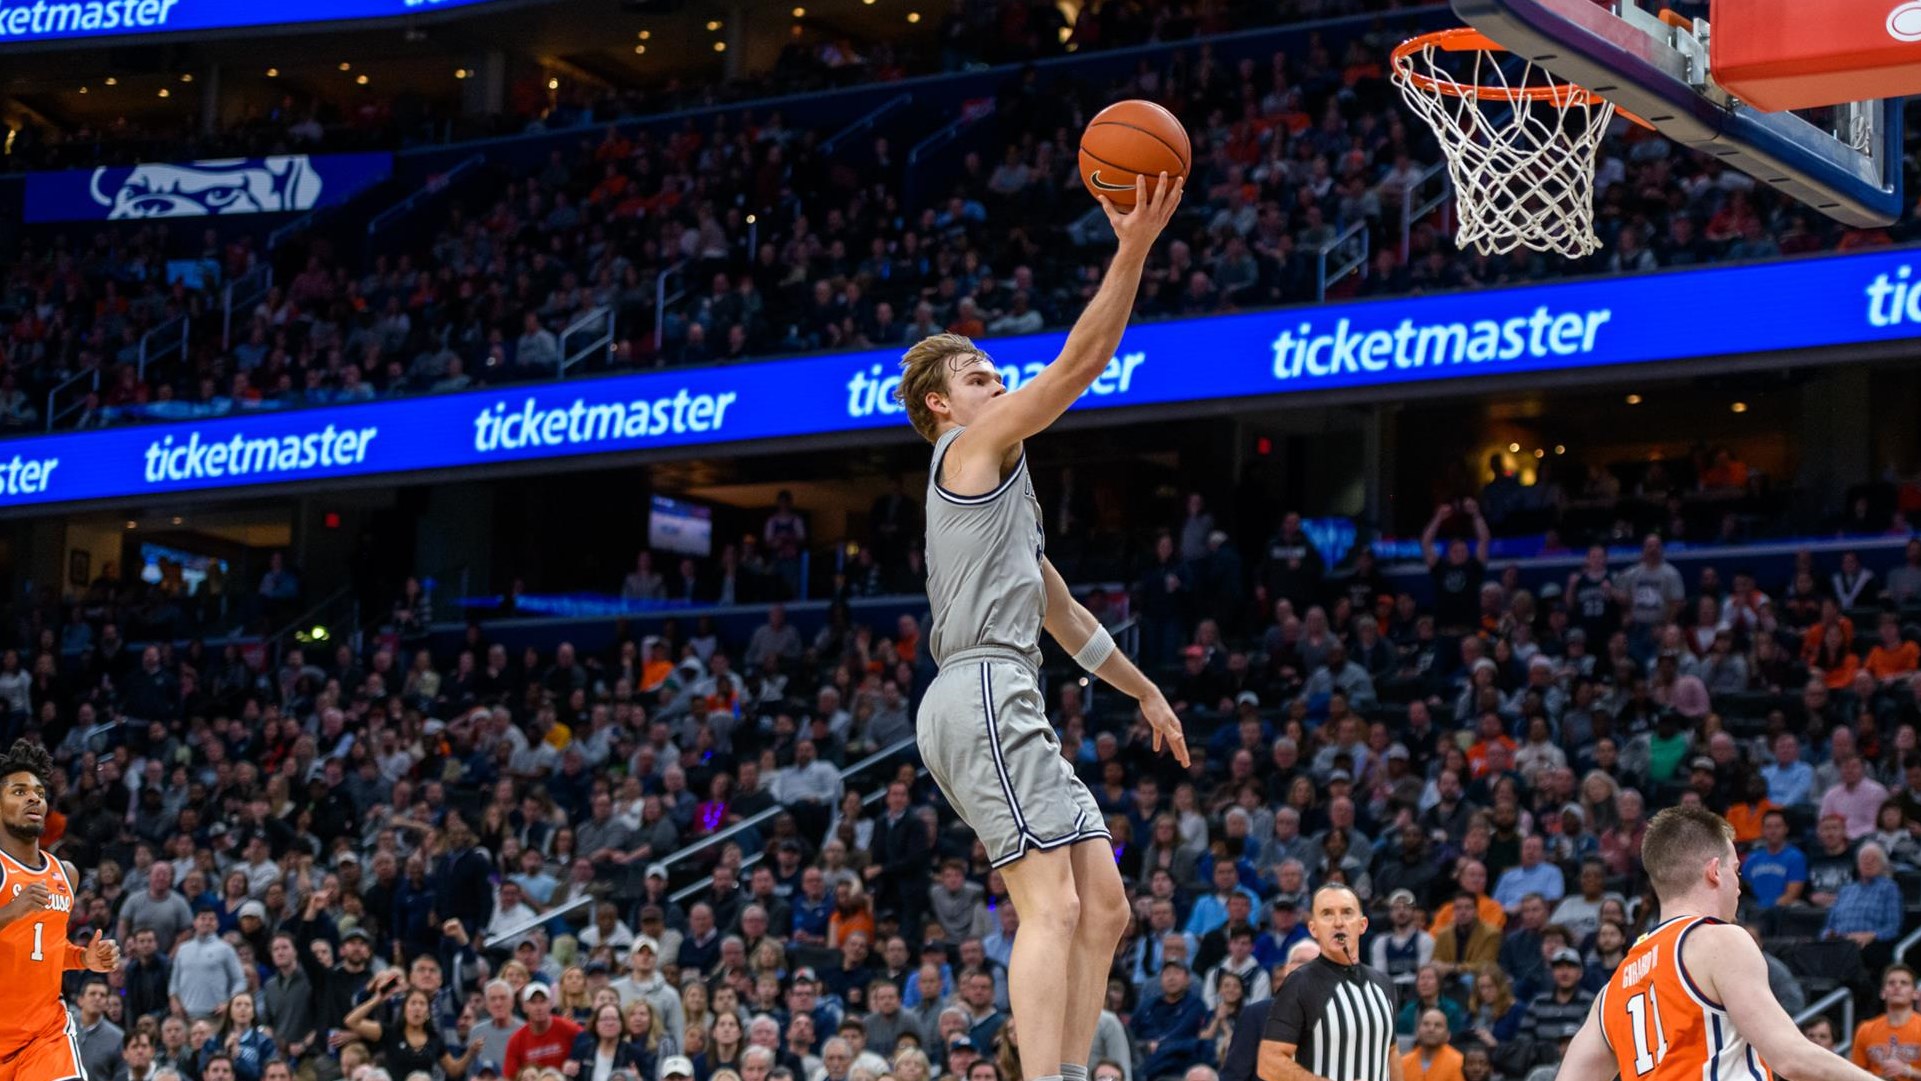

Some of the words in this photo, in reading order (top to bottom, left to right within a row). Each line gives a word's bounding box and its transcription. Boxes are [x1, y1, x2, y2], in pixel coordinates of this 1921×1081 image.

[1272, 306, 1611, 379] ticketmaster
[144, 424, 377, 482] ticketmaster
[473, 388, 736, 453] ticketmaster
[31, 921, 44, 961] 1
[1626, 979, 1668, 1077] 11
